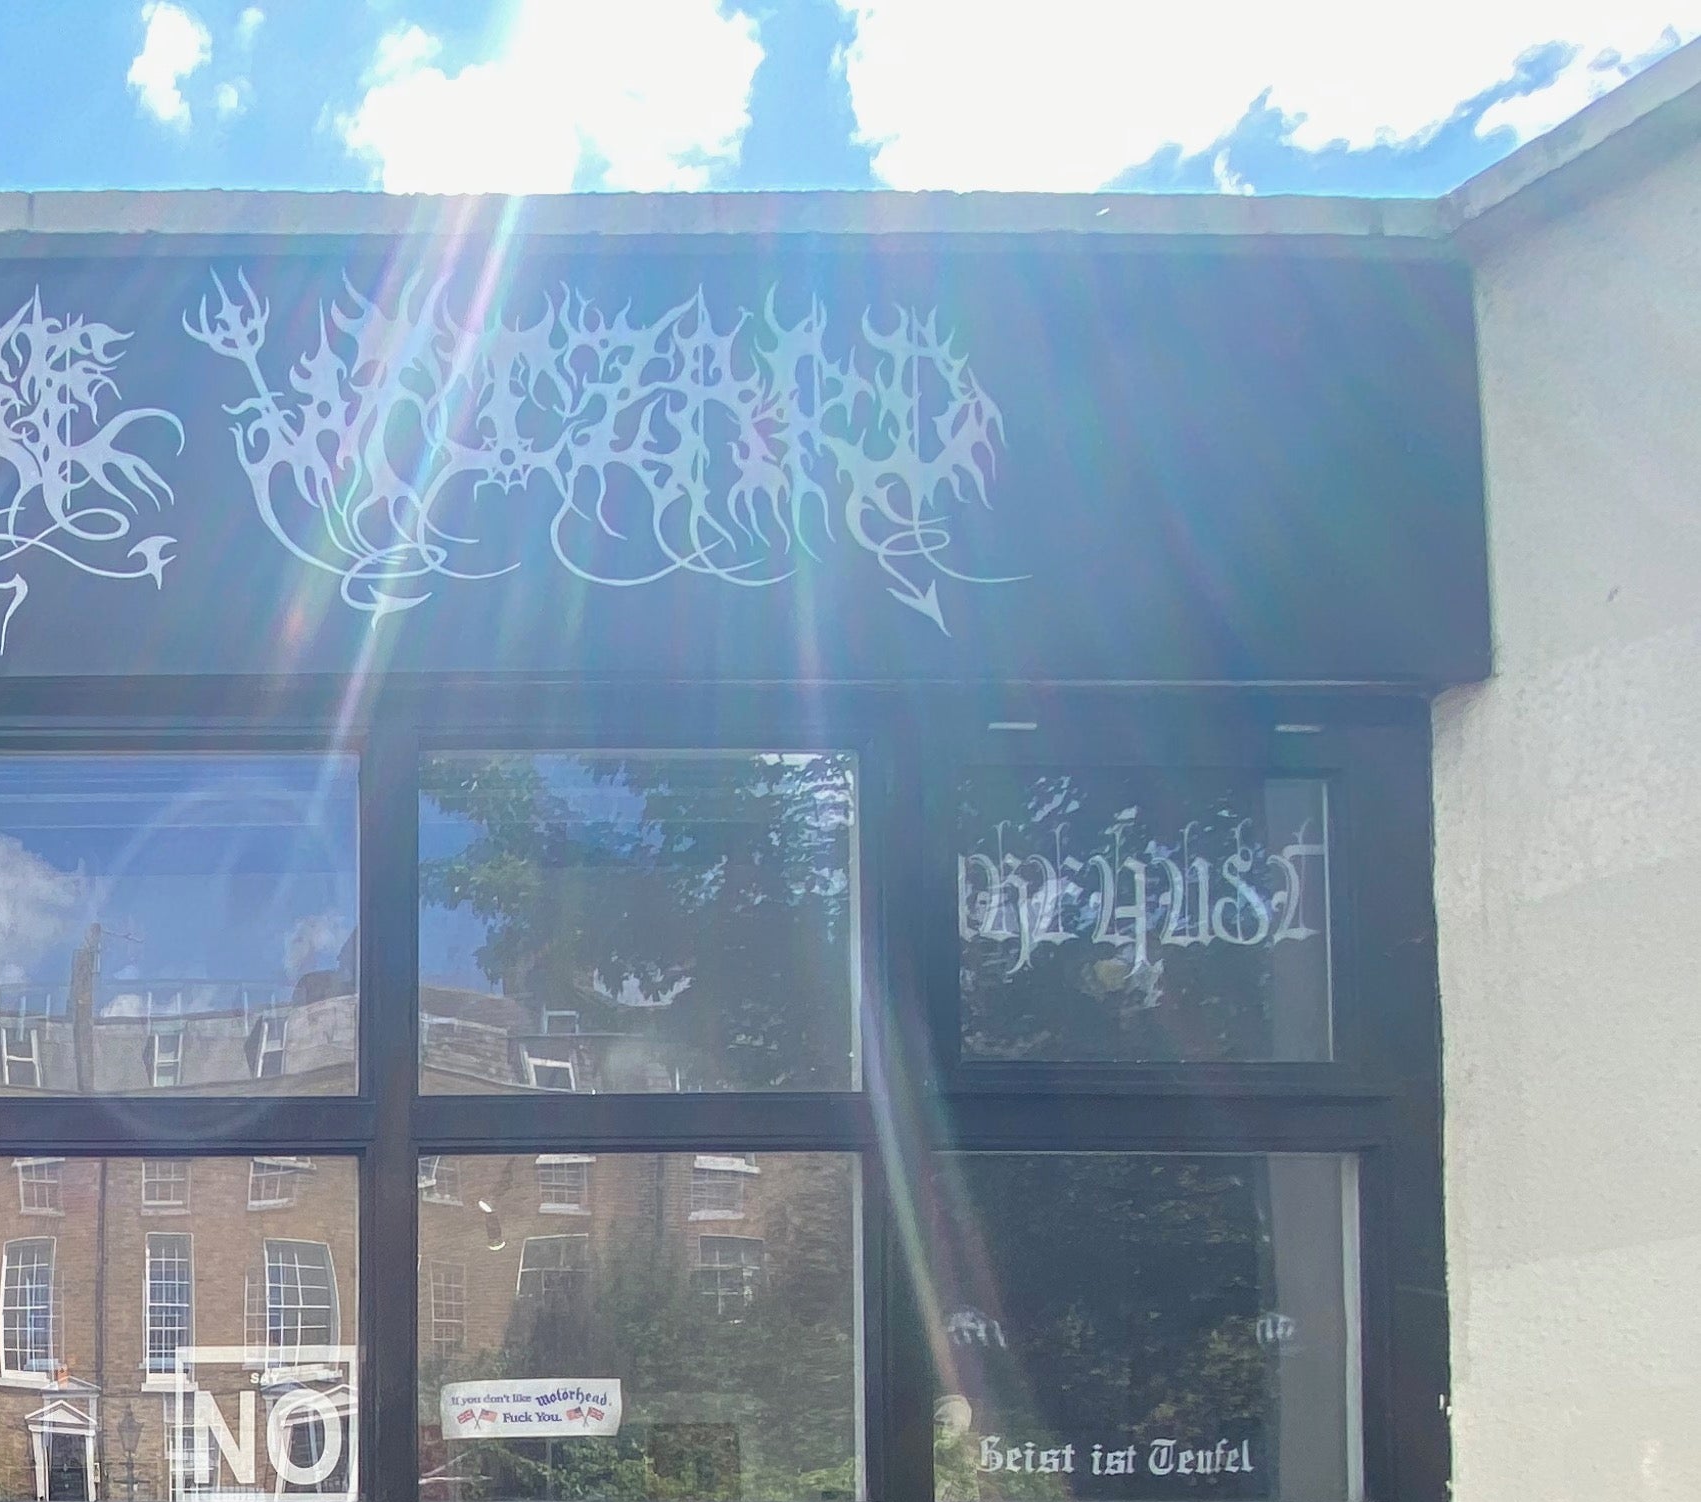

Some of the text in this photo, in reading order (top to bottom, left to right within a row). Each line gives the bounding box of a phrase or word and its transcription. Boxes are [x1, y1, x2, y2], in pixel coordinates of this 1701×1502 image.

[462, 1397, 482, 1406] you
[483, 1393, 510, 1404] don't
[512, 1393, 532, 1404] like
[502, 1411, 563, 1424] Fuck You.
[194, 1389, 342, 1485] NO
[1091, 1443, 1137, 1476] ist
[1148, 1437, 1255, 1476] Teufel
